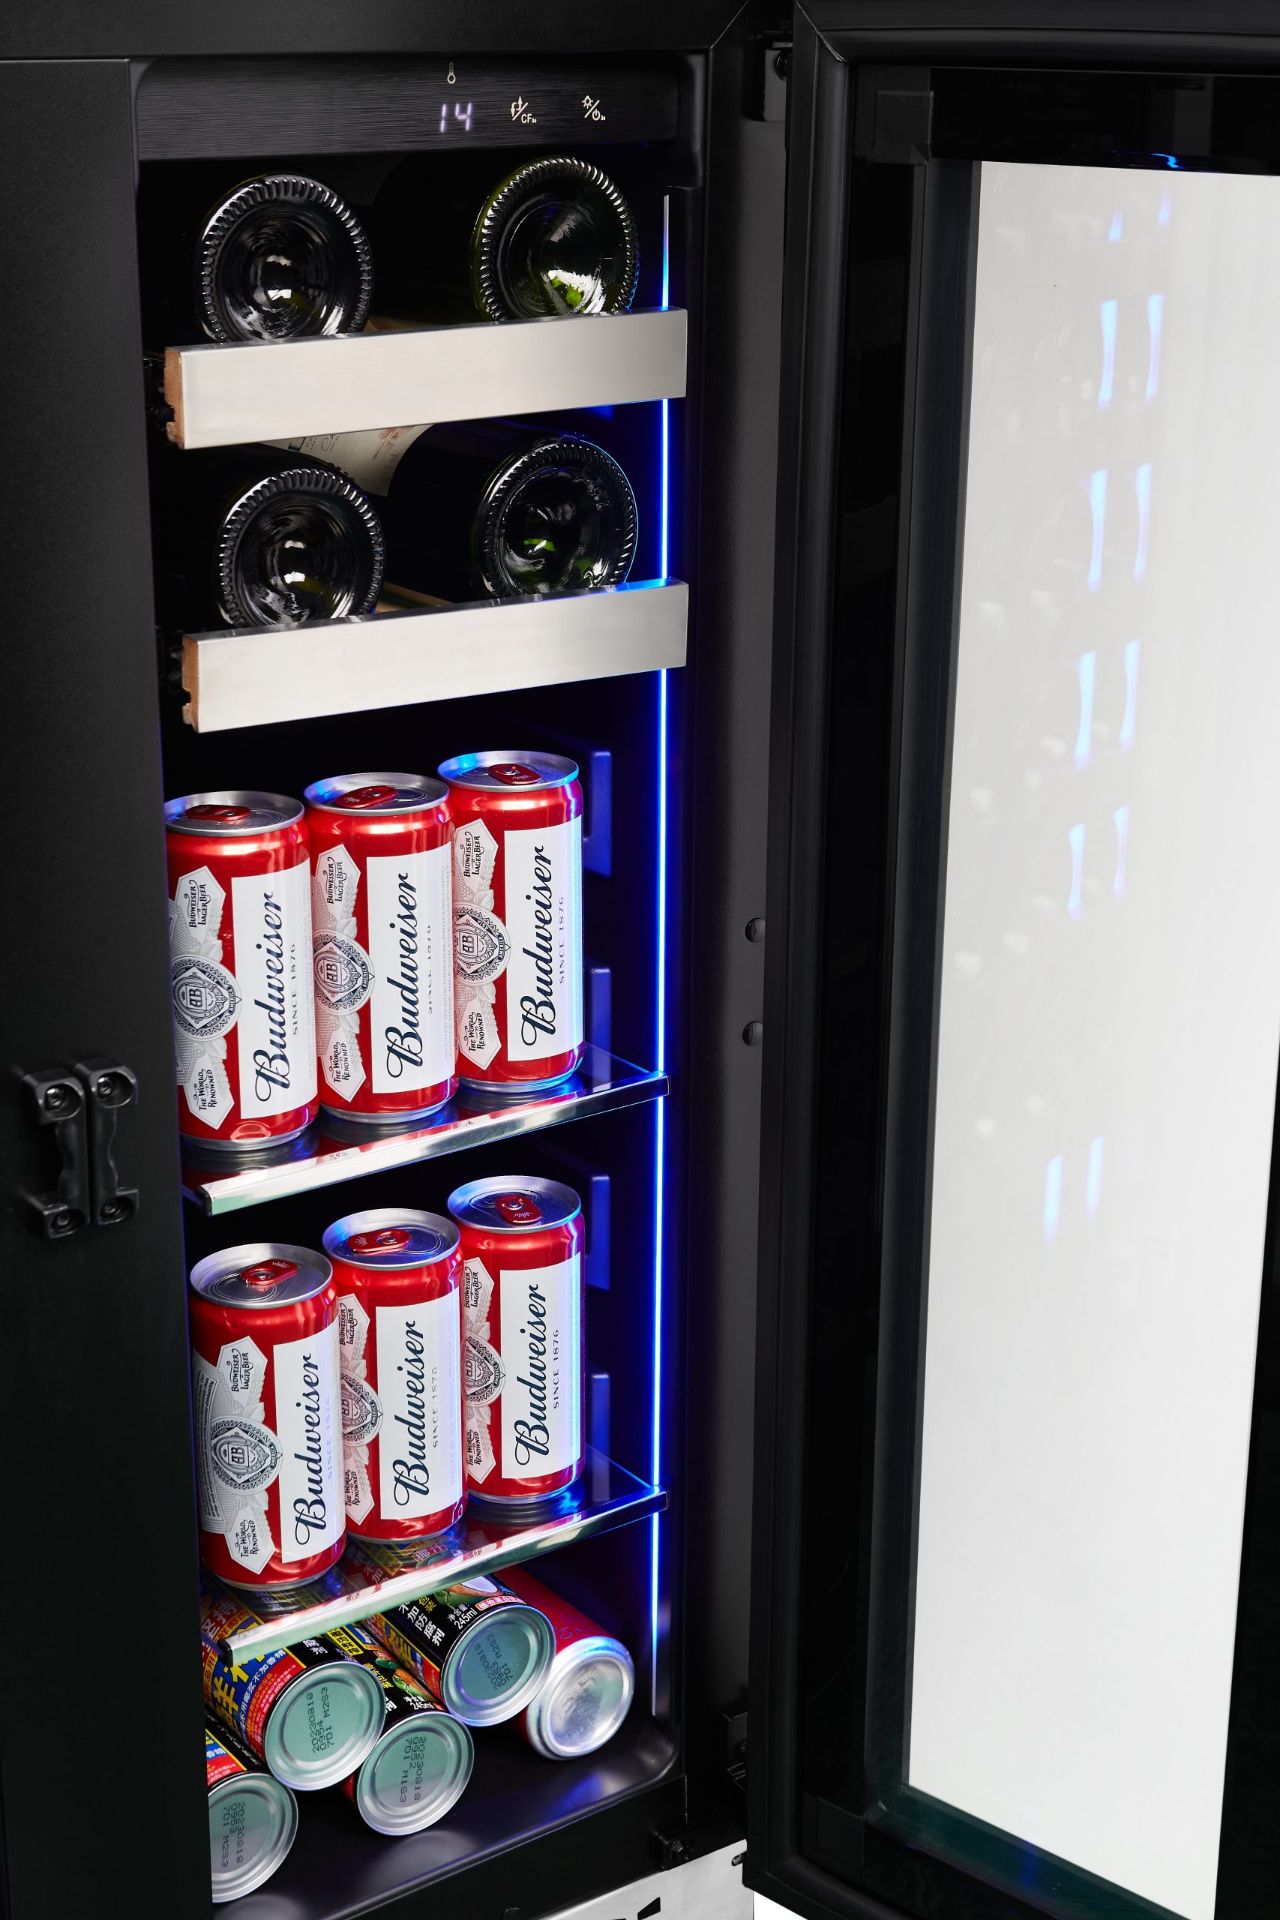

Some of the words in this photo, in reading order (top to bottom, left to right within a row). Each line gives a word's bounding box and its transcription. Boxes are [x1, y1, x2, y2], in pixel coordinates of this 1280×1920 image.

[440, 103, 471, 133] 14
[253, 891, 290, 1101] Budweiser
[385, 872, 423, 1078] Budweiser
[520, 845, 556, 1046] Budweiser
[393, 1320, 429, 1505] Budweiser
[514, 1284, 550, 1465] Budweiser
[293, 1353, 326, 1545] Budweiser
[454, 1608, 478, 1630] 245ml
[502, 1663, 513, 1681] 701
[325, 1725, 335, 1748] 701
[404, 1738, 412, 1760] 701
[223, 1804, 231, 1826] 701
